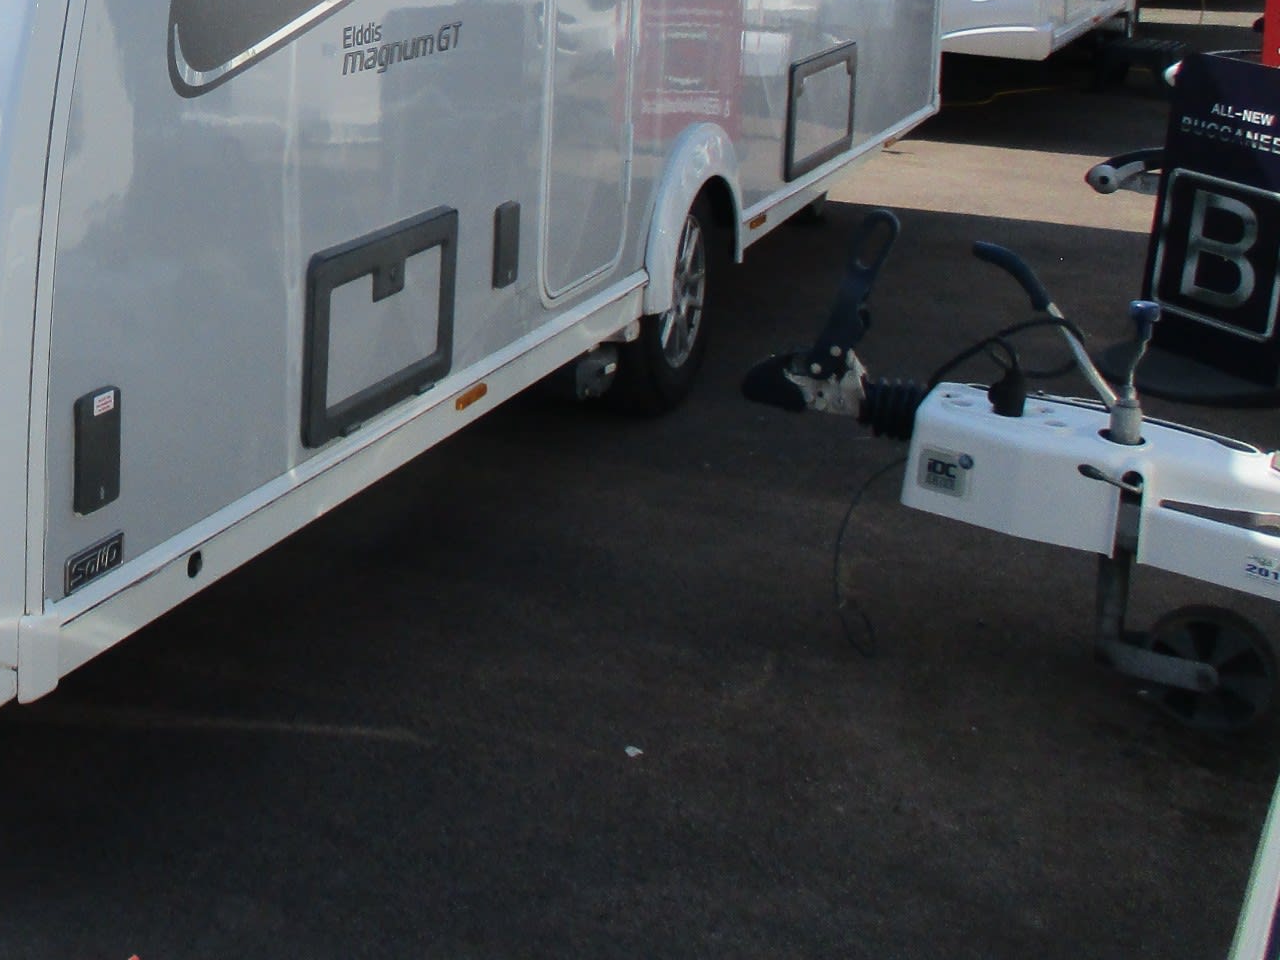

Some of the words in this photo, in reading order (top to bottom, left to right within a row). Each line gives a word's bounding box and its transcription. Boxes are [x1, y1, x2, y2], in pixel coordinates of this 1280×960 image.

[343, 22, 382, 49] Elddis
[1210, 103, 1275, 127] ALL-NEW
[1180, 189, 1258, 309] B
